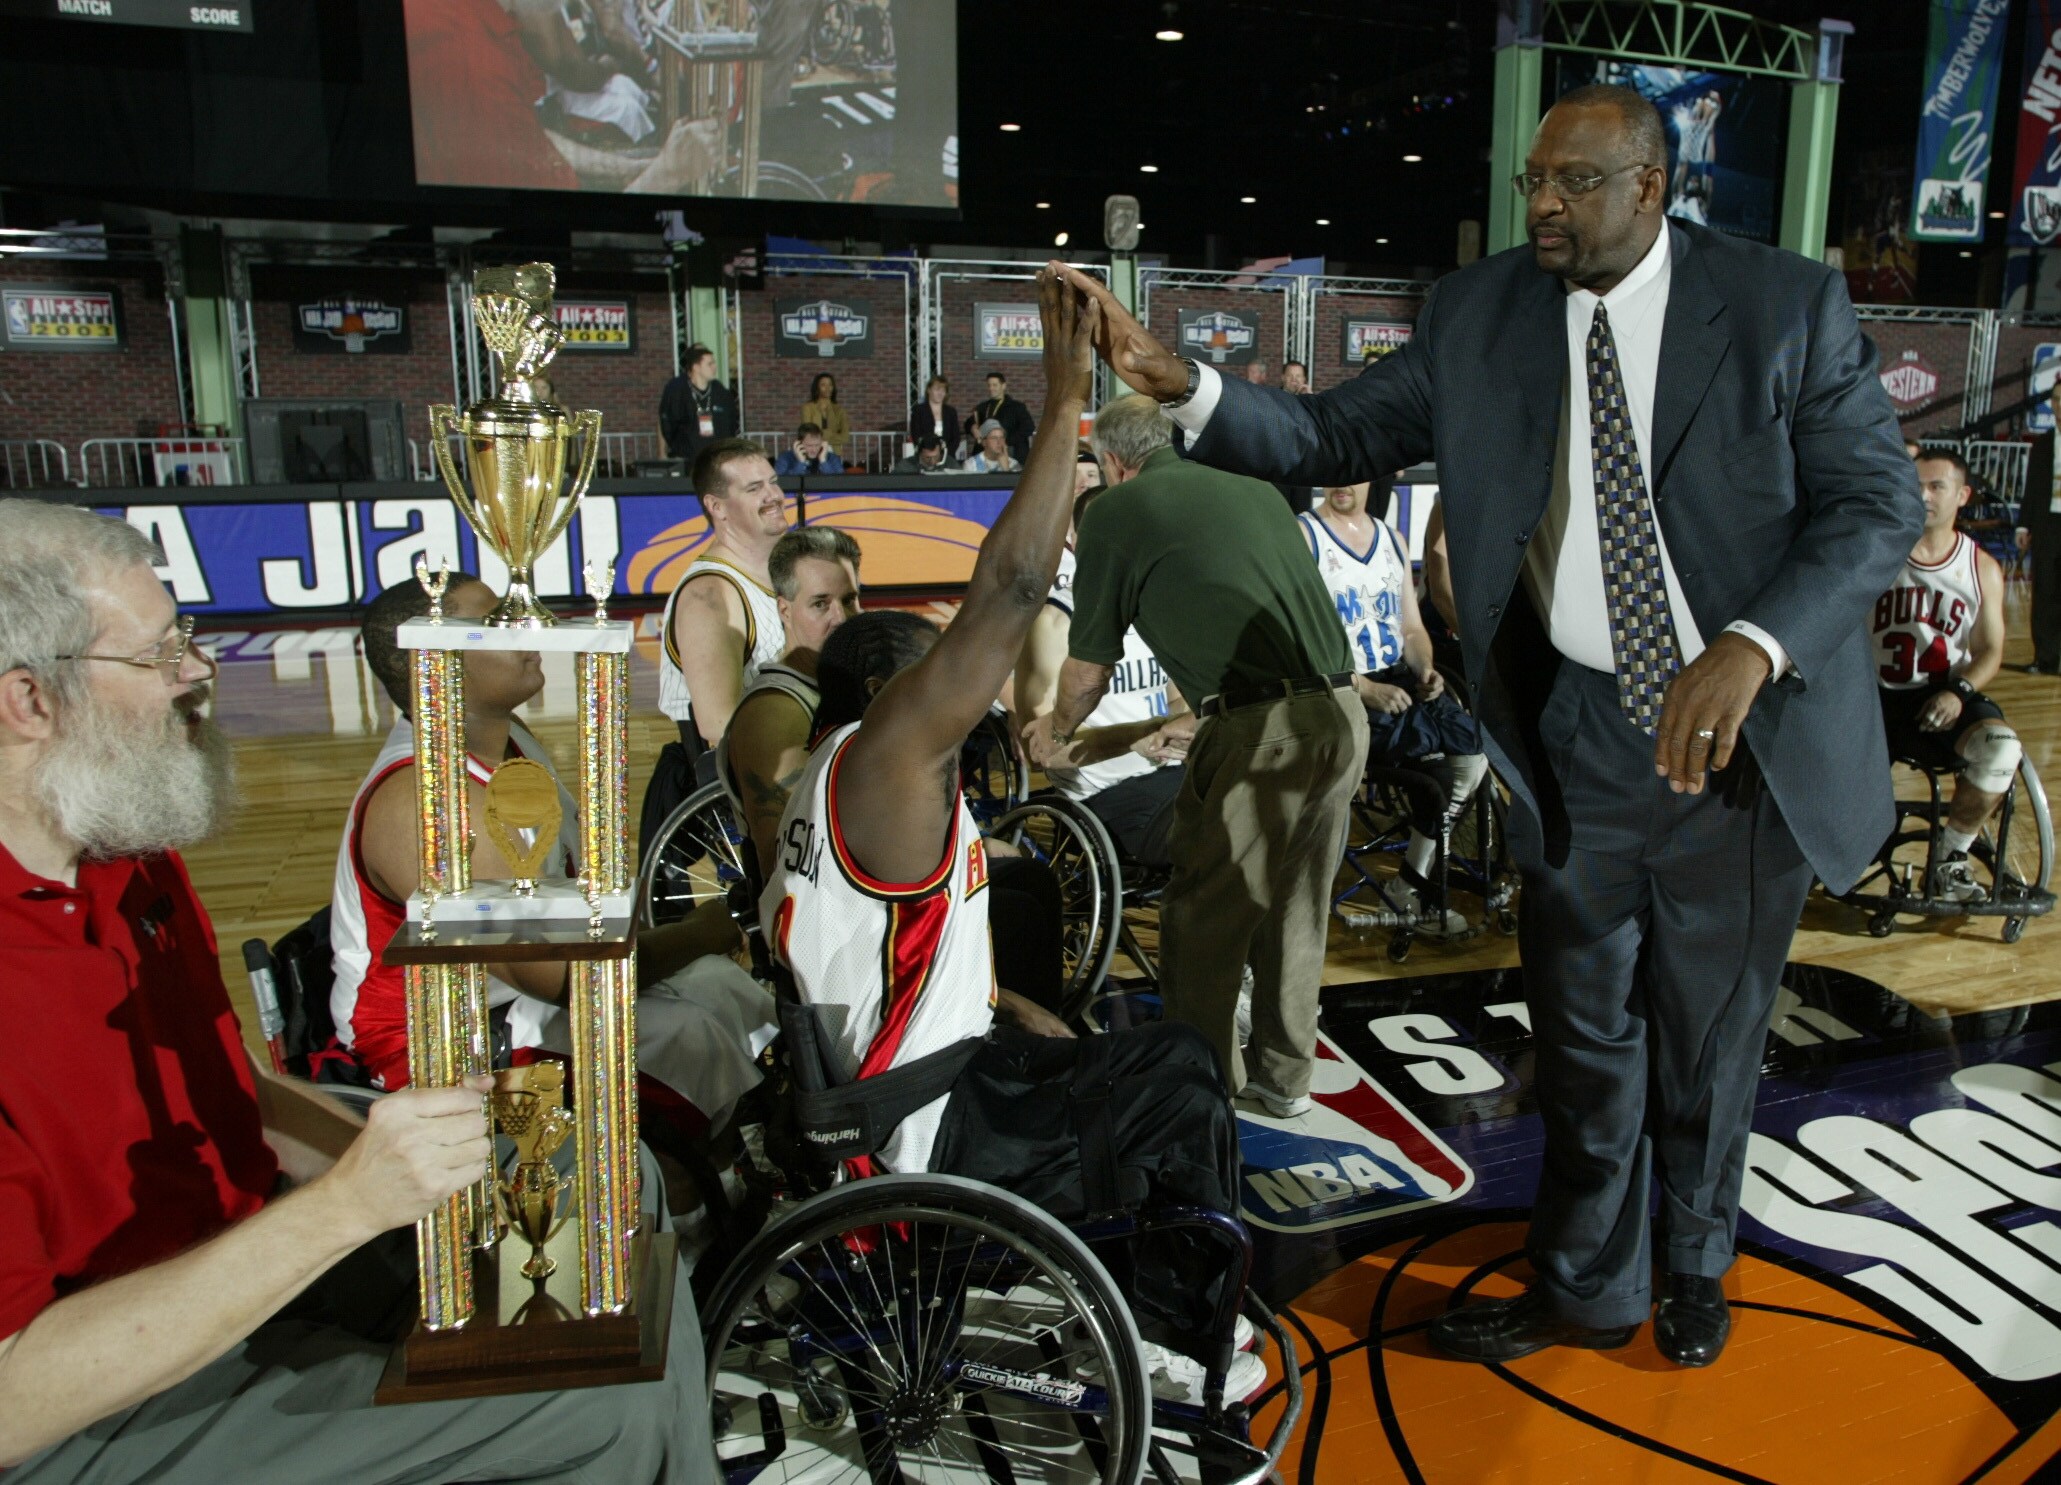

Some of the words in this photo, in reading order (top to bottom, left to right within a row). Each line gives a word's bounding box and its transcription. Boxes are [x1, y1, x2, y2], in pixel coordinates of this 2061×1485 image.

[57, 0, 112, 16] MATCH
[190, 7, 240, 25] SCORE
[1872, 585, 1967, 637] BULLS
[1356, 621, 1399, 671] 15
[1879, 631, 1952, 685] 34
[1245, 1153, 1406, 1213] NBA
